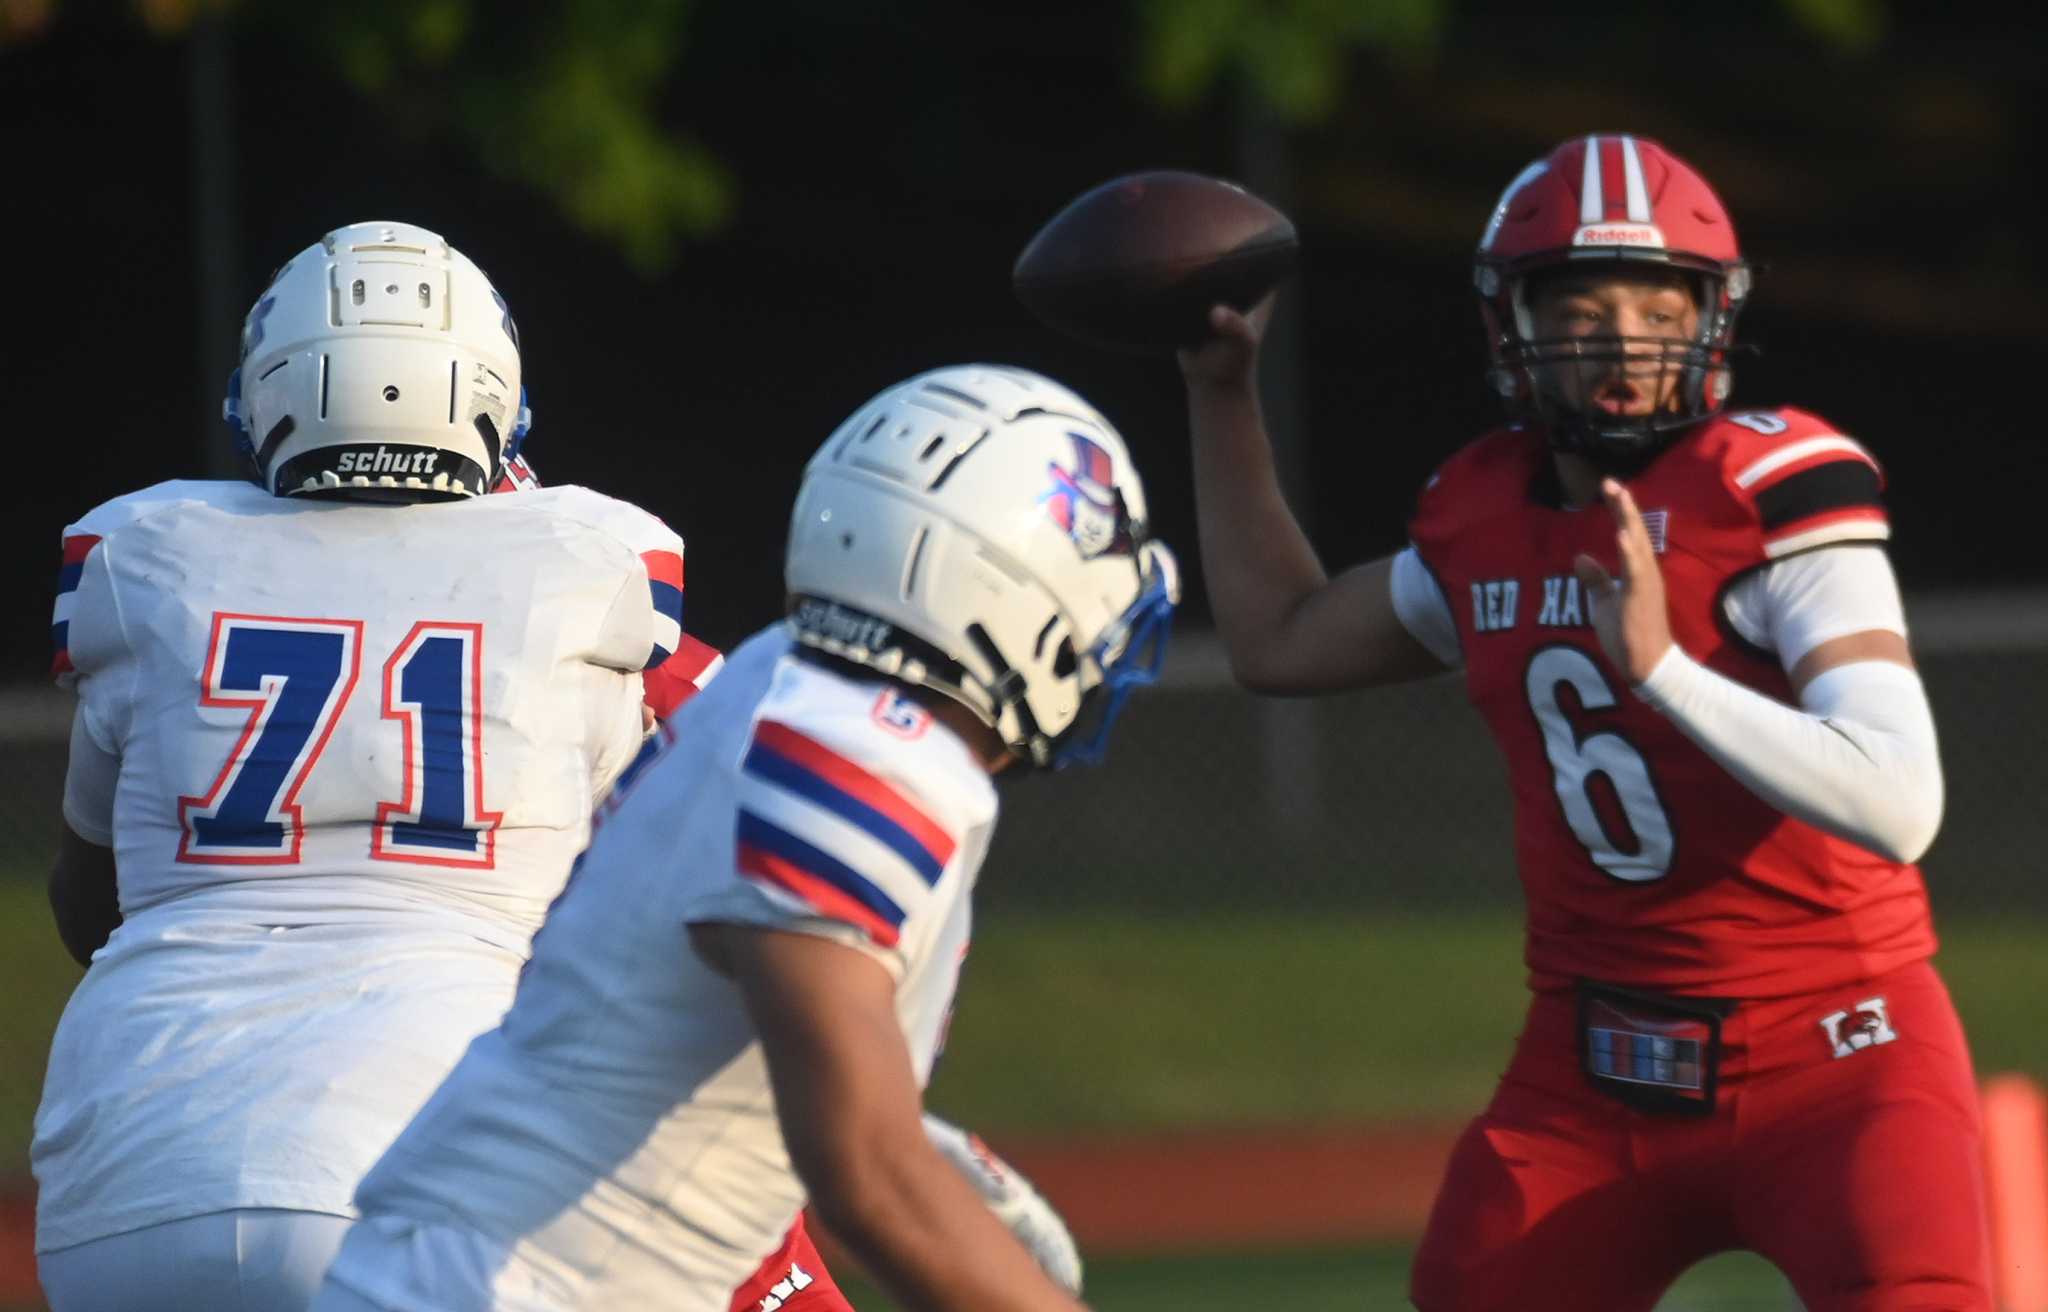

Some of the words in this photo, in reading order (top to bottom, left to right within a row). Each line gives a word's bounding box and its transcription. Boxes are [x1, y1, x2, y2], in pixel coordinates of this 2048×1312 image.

[337, 445, 439, 474] schutt
[1471, 580, 1519, 632] RED
[175, 611, 504, 870] 71
[1525, 645, 1675, 882] 6
